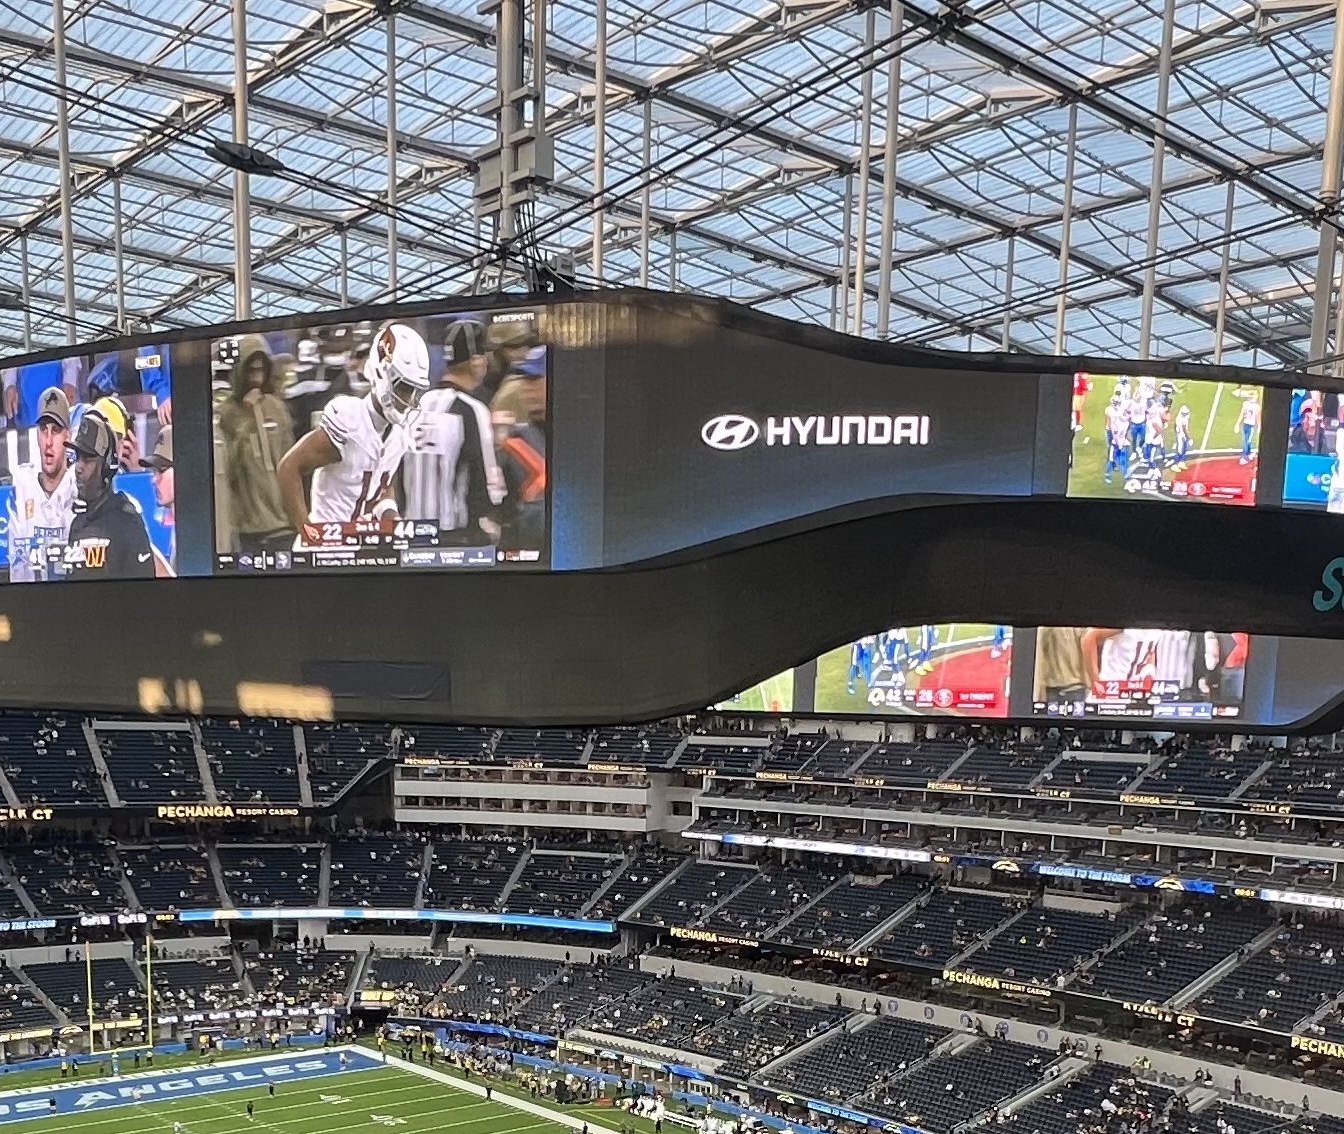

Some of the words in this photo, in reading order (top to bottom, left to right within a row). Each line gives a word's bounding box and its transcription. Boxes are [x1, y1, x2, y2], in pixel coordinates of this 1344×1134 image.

[767, 416, 930, 446] HYUNDAI
[322, 524, 343, 540] 22
[394, 522, 415, 539] 44
[158, 805, 234, 818] PECHANGA
[670, 927, 718, 943] PECHANGA
[943, 969, 1000, 989] PECHANGA
[73, 1059, 329, 1107] ANGELES
